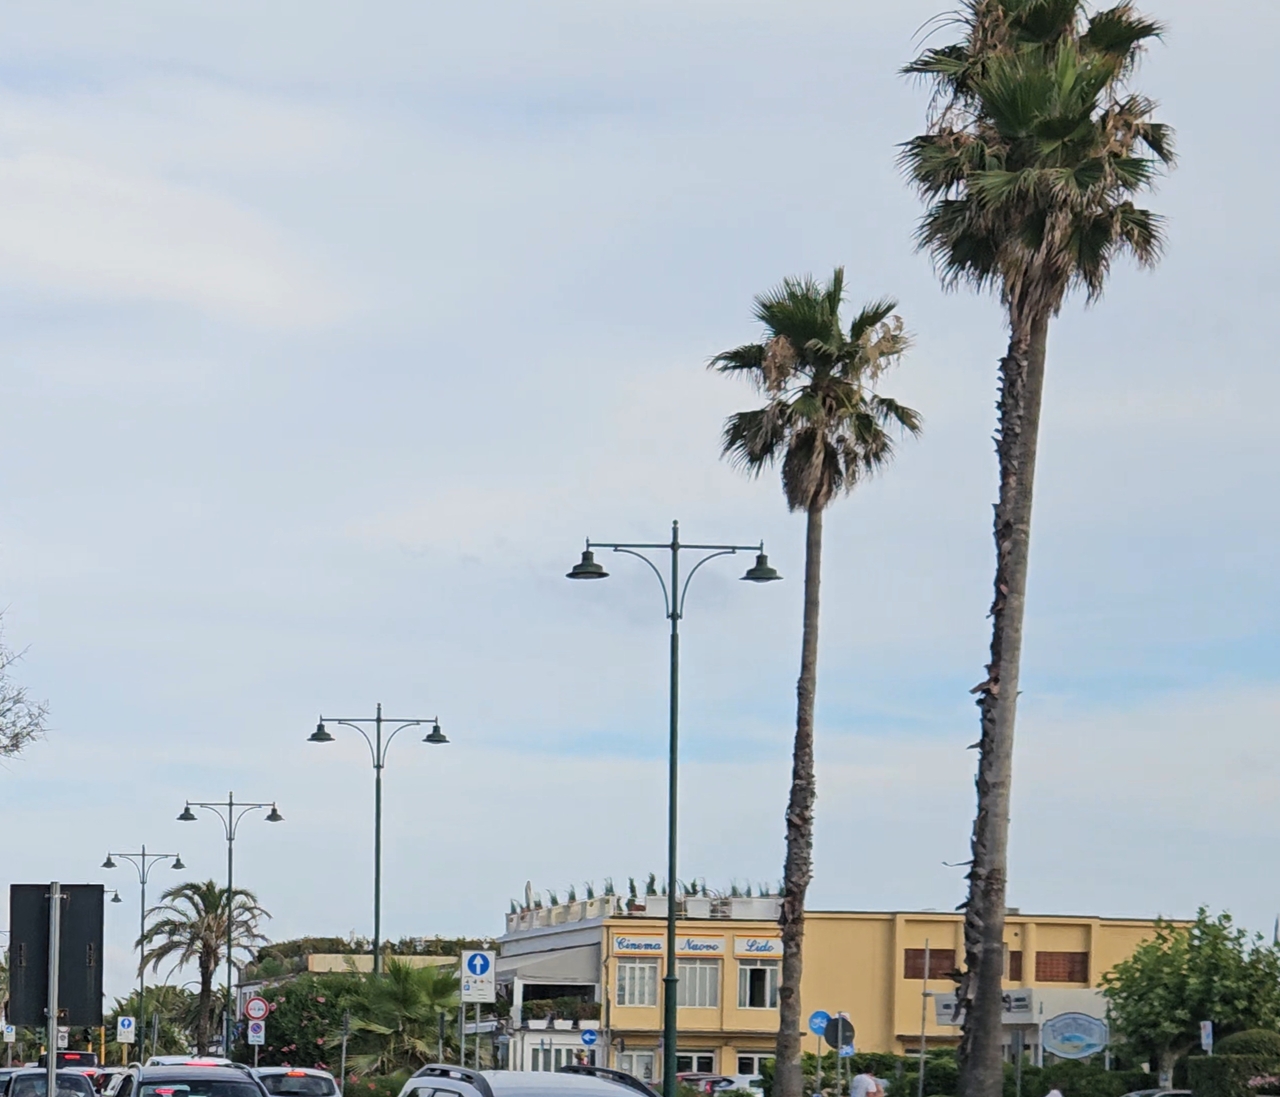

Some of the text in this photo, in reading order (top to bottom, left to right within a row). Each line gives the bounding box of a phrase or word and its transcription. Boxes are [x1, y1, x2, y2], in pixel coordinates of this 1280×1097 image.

[615, 936, 774, 953] Cinema Nuovo Lido
